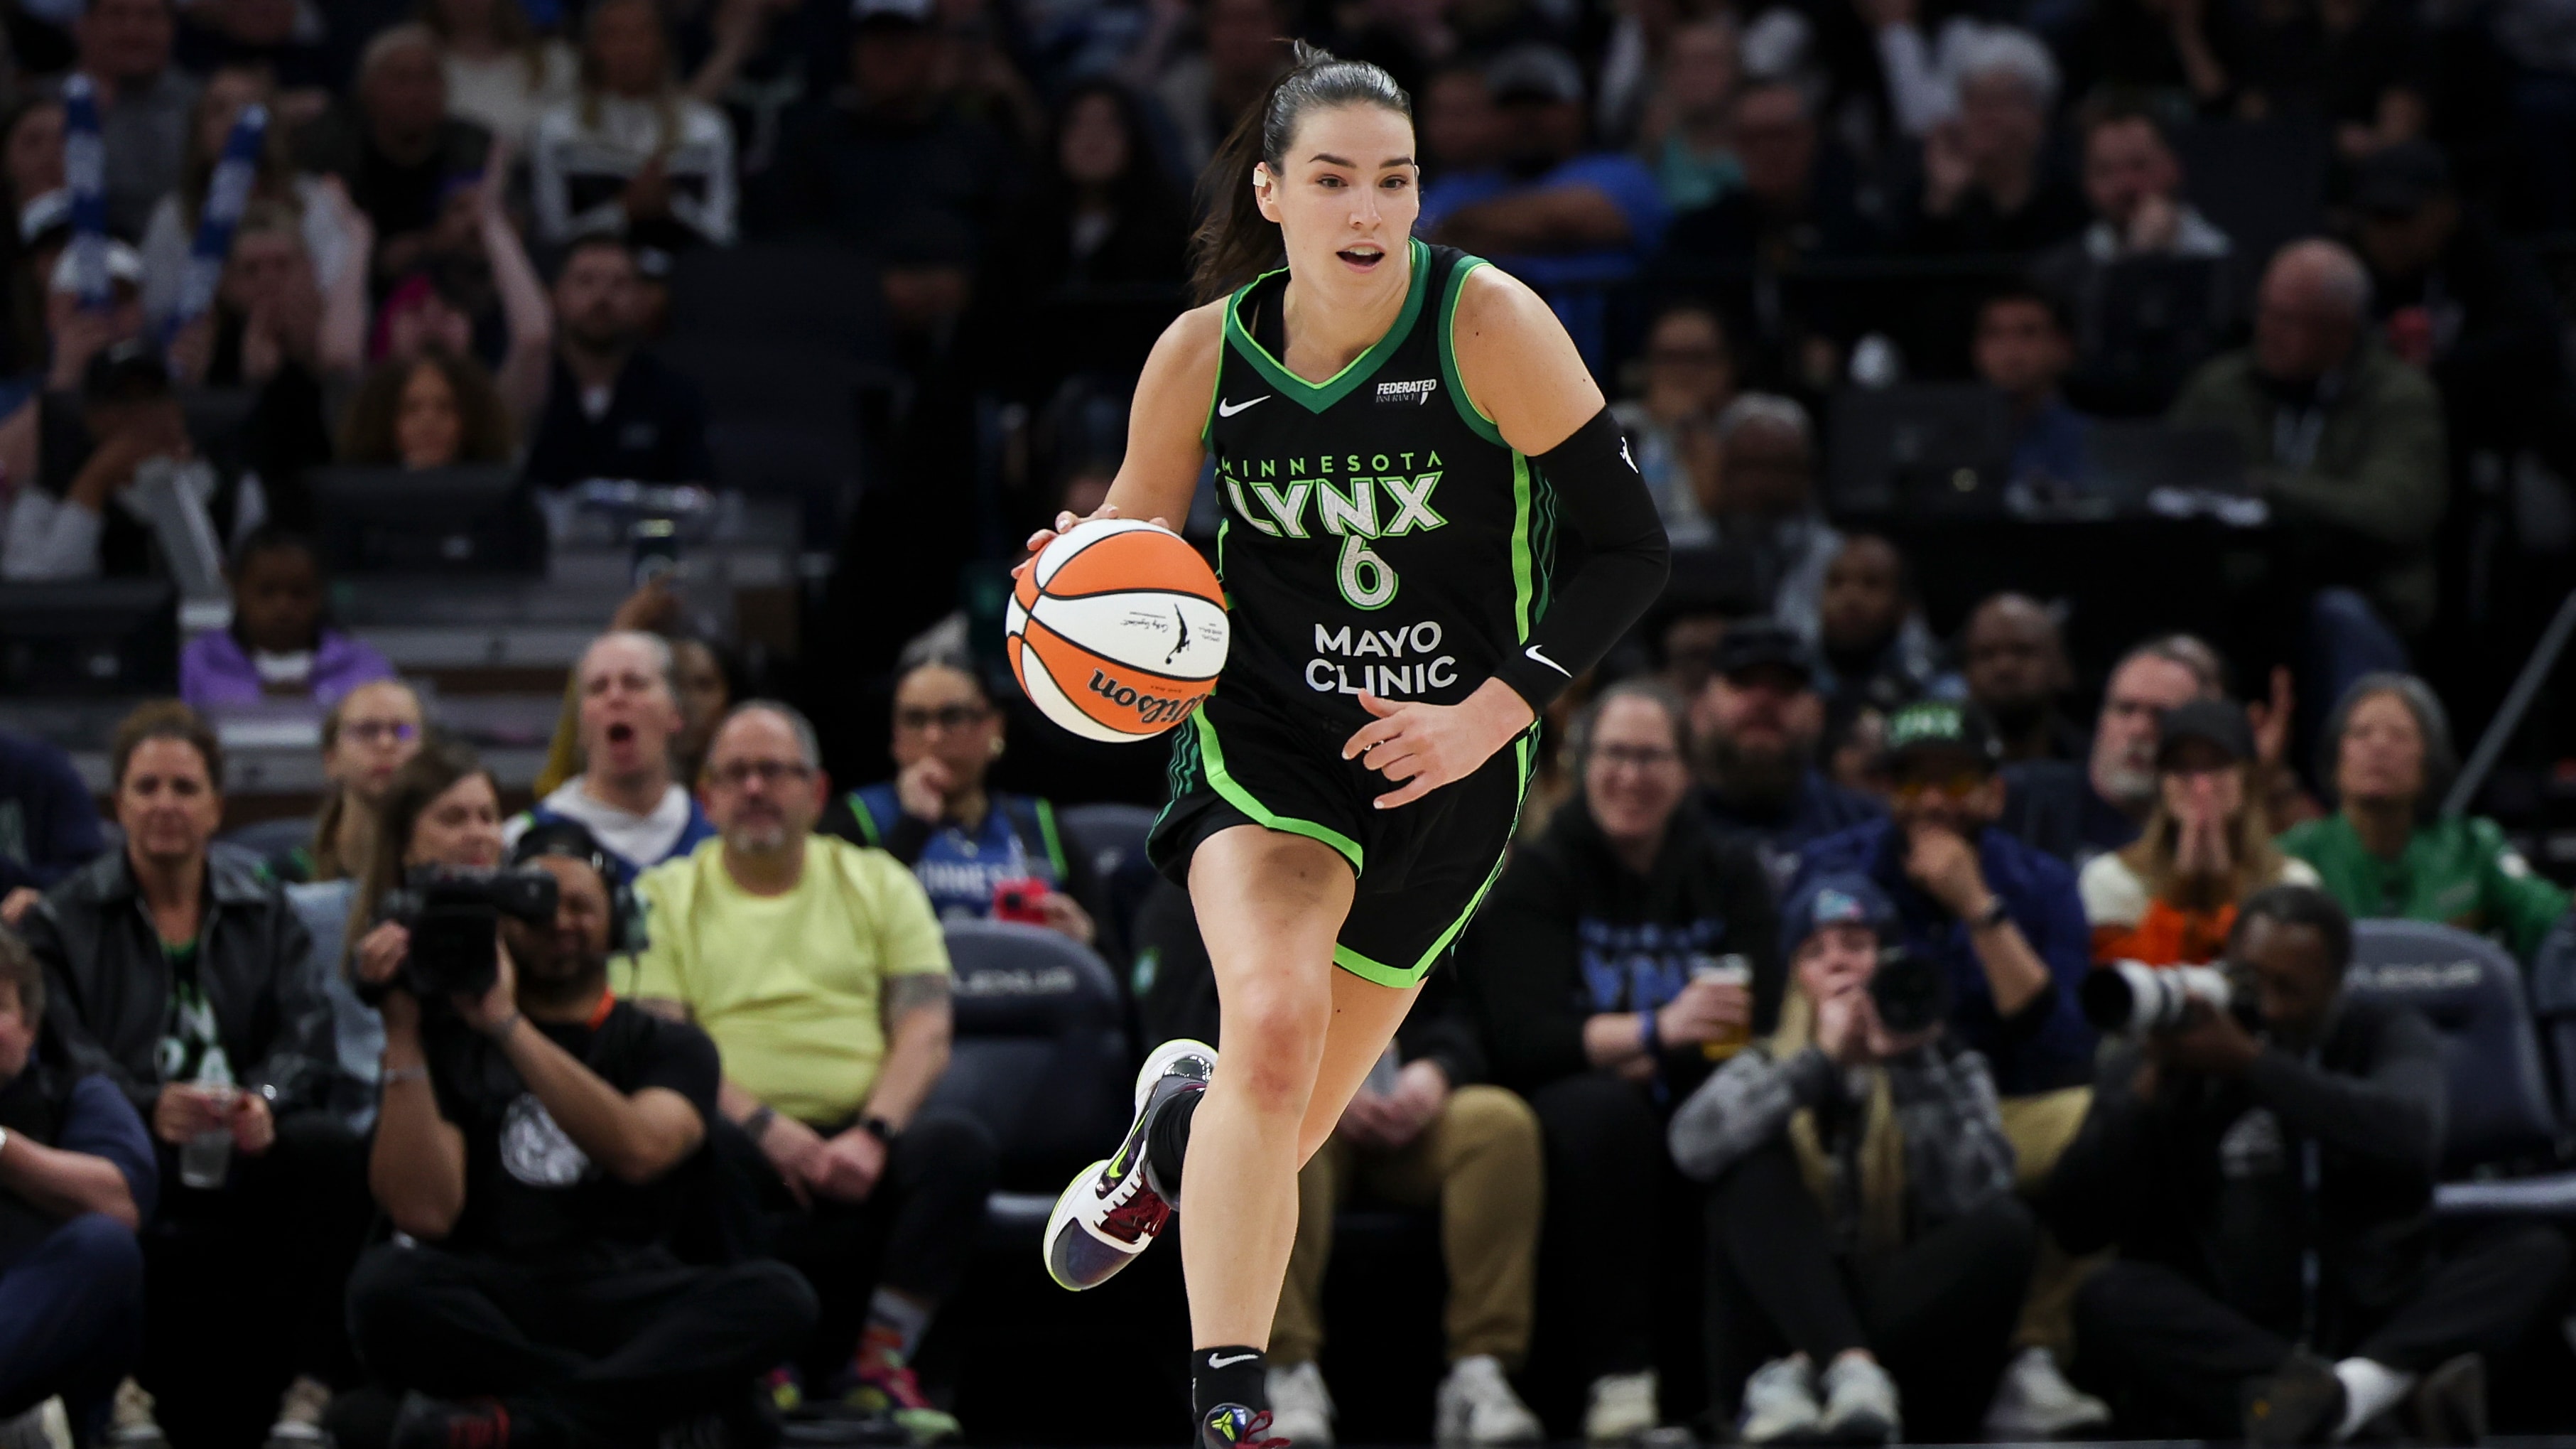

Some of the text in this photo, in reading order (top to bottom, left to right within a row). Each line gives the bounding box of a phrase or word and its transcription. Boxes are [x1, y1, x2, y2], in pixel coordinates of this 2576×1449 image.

[1377, 379, 1436, 394] FEDERATED
[1222, 451, 1442, 478] MINNESOTA
[1225, 470, 1449, 540] LYNX
[1336, 534, 1399, 610] 6
[1315, 621, 1442, 657] MAYO
[1306, 656, 1458, 696] CLINIC
